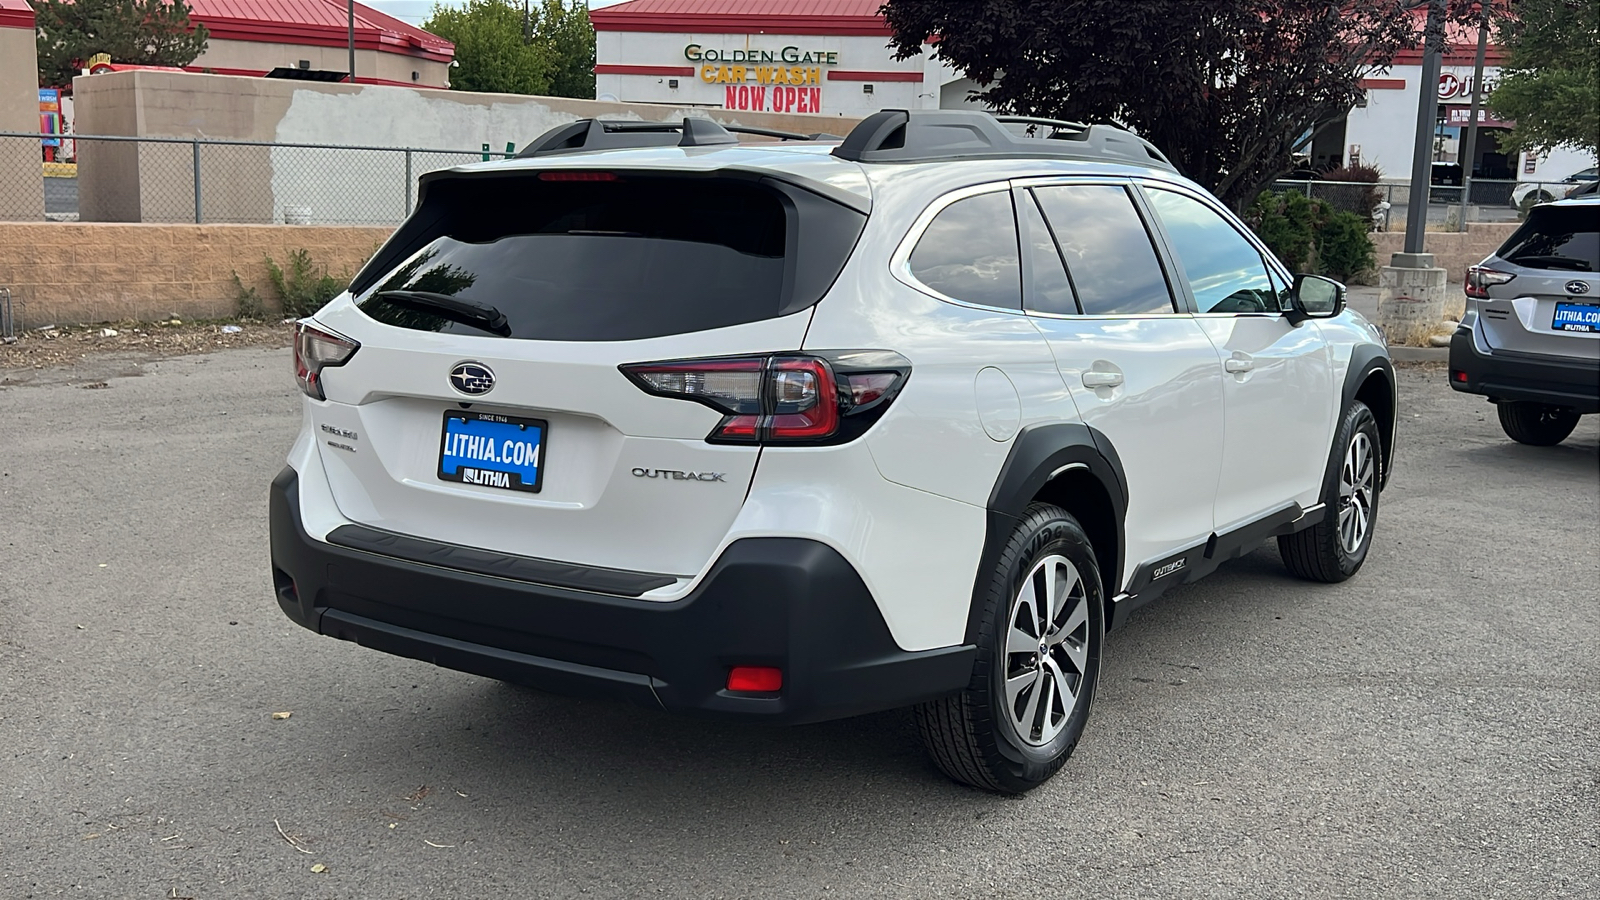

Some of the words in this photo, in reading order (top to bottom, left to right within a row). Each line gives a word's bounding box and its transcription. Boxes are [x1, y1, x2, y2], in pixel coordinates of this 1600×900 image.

[684, 44, 774, 64] GOLDEN
[781, 46, 838, 65] GATE
[701, 65, 747, 84] CAR
[754, 66, 821, 85] WASH
[725, 85, 766, 112] NOW
[773, 87, 821, 113] OPEN
[478, 413, 495, 422] SINCE
[443, 432, 540, 468] LITHIA.COM
[473, 469, 510, 488] LITHIA
[631, 467, 727, 483] OUTBACK
[1153, 557, 1186, 577] OUTBACK
